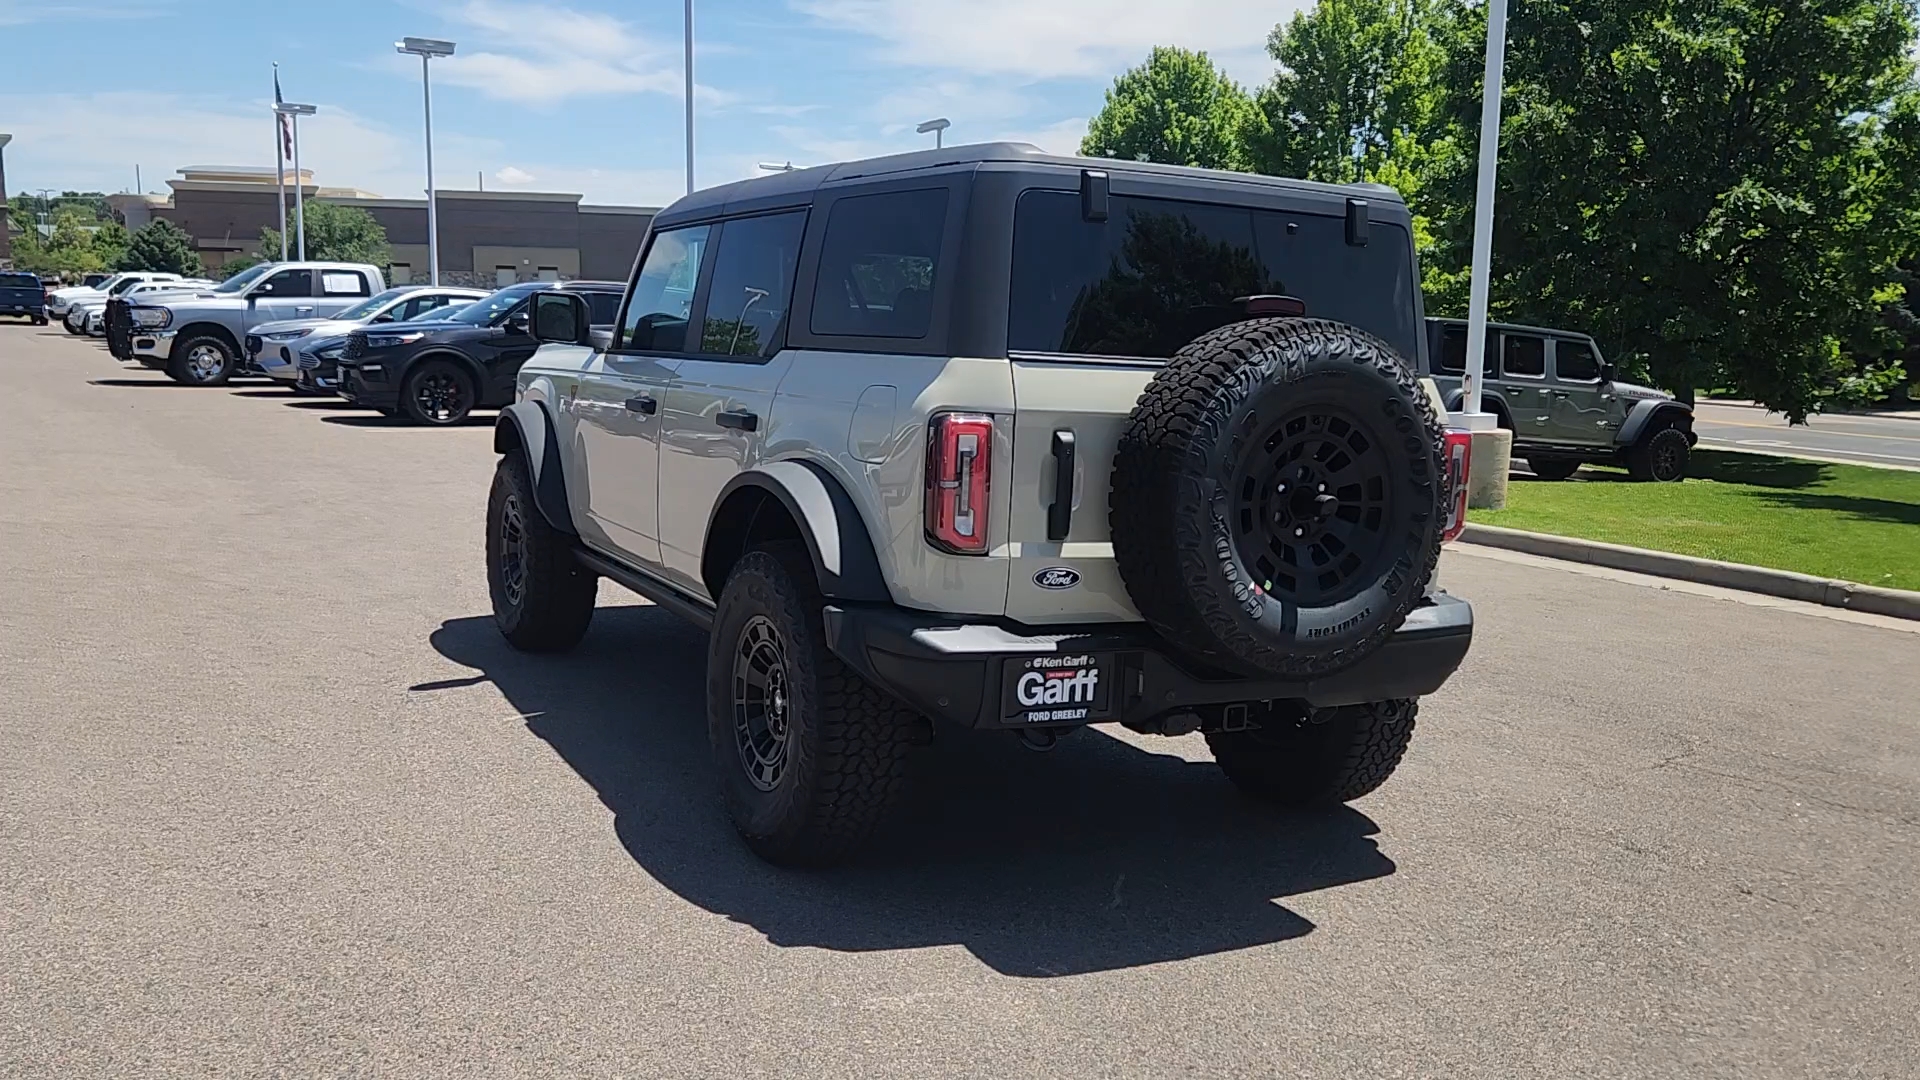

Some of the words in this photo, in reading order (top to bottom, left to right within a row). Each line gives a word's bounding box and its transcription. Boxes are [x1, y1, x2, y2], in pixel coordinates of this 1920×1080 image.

[1628, 390, 1669, 401] RUBICON
[1043, 571, 1073, 585] Ford
[1306, 607, 1372, 638] TERRITORY
[1042, 657, 1062, 668] Ken
[1063, 655, 1088, 667] Garff
[1017, 669, 1098, 707] Garff
[1028, 711, 1050, 722] FORD
[1051, 708, 1088, 720] GREELEY
